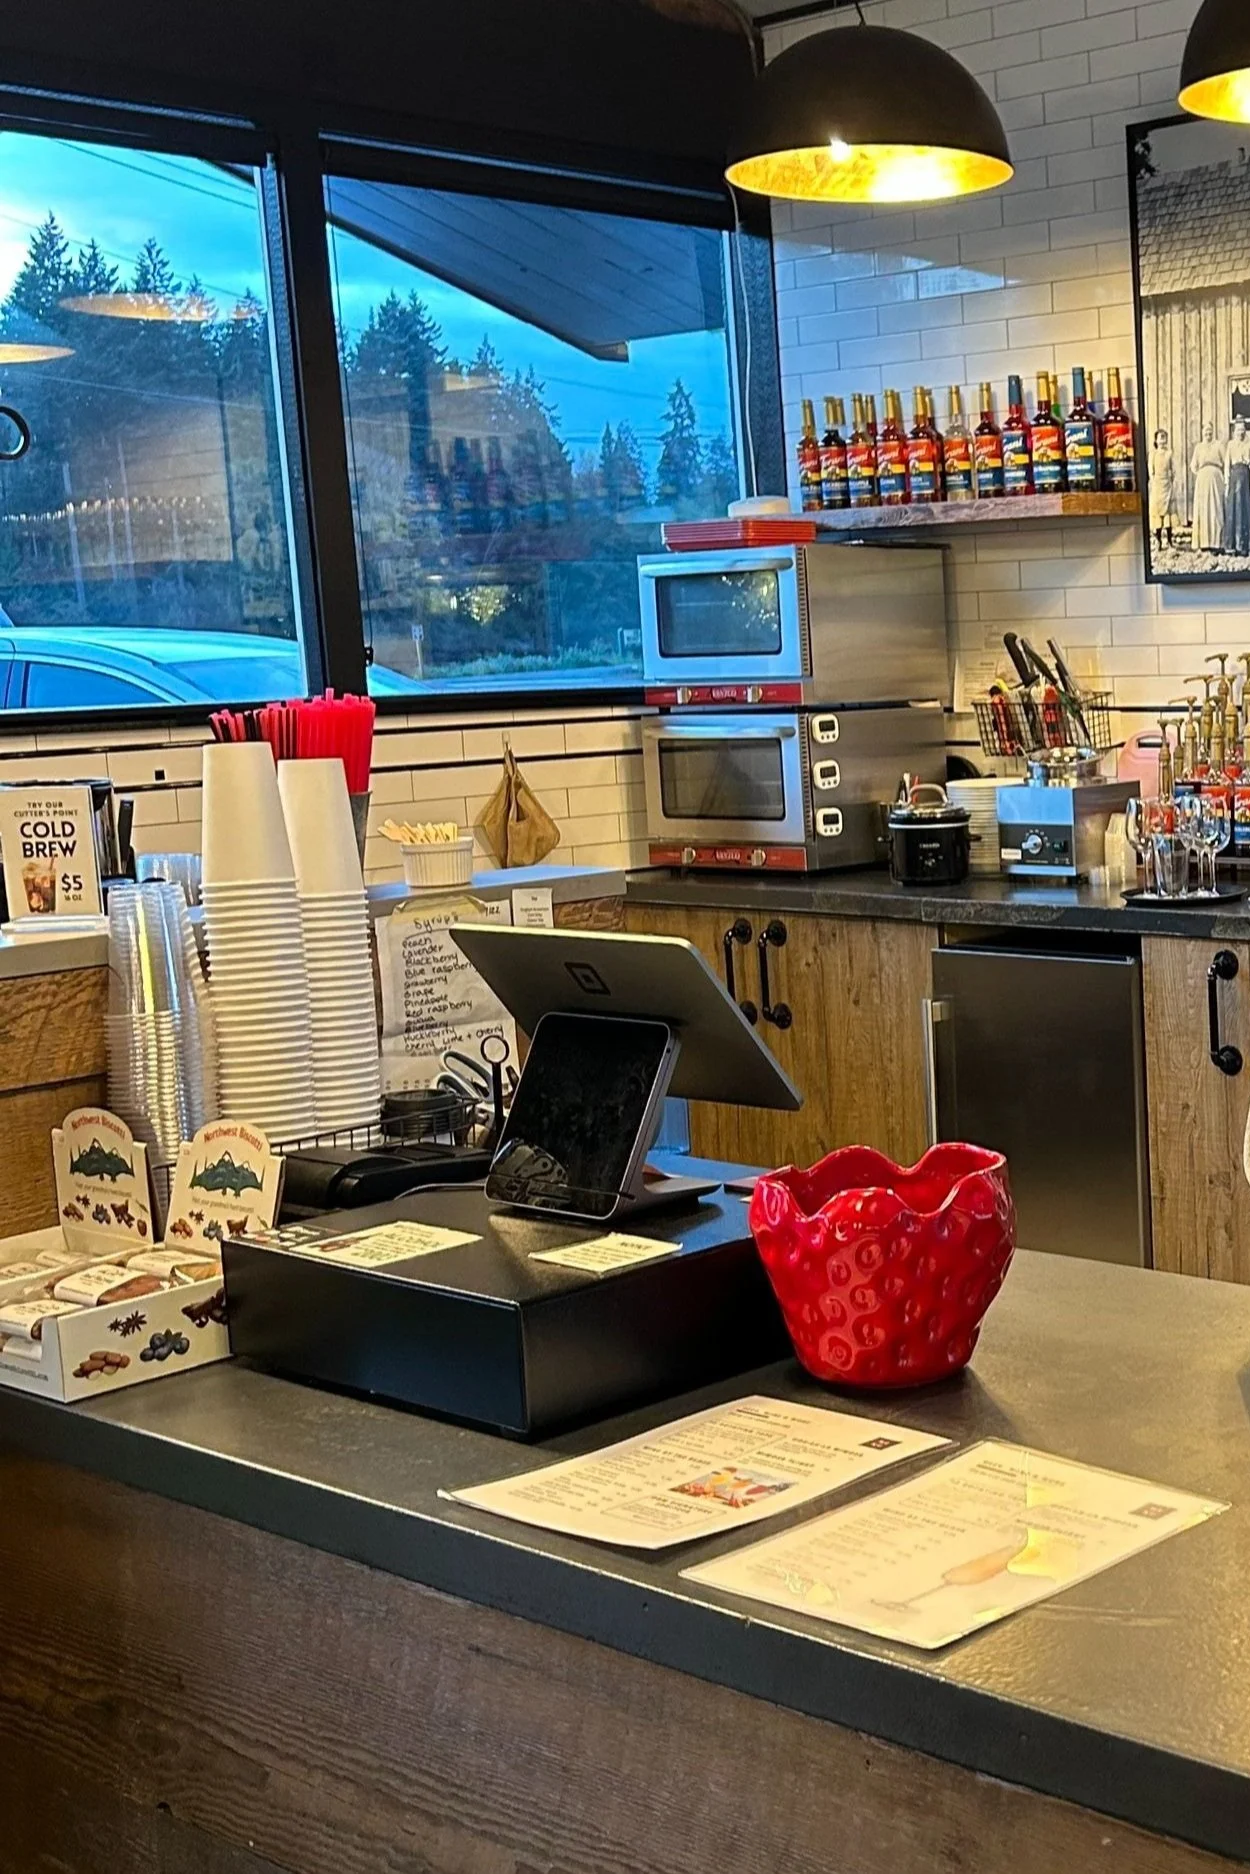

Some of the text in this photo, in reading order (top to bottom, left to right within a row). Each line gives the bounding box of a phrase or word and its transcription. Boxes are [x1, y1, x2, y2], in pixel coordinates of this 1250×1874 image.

[53, 809, 78, 817] POINT
[20, 821, 75, 838] COLD
[22, 840, 77, 858] BREW
[61, 873, 83, 893] $5
[402, 937, 432, 948] Peach
[402, 945, 443, 958] Lavender
[405, 952, 458, 967] Blackberry
[405, 968, 425, 979] Blue
[405, 1000, 473, 1018] Red raspberry
[71, 1116, 126, 1140] Northwest Biscotti
[203, 1127, 264, 1151] Northwest Biscotti
